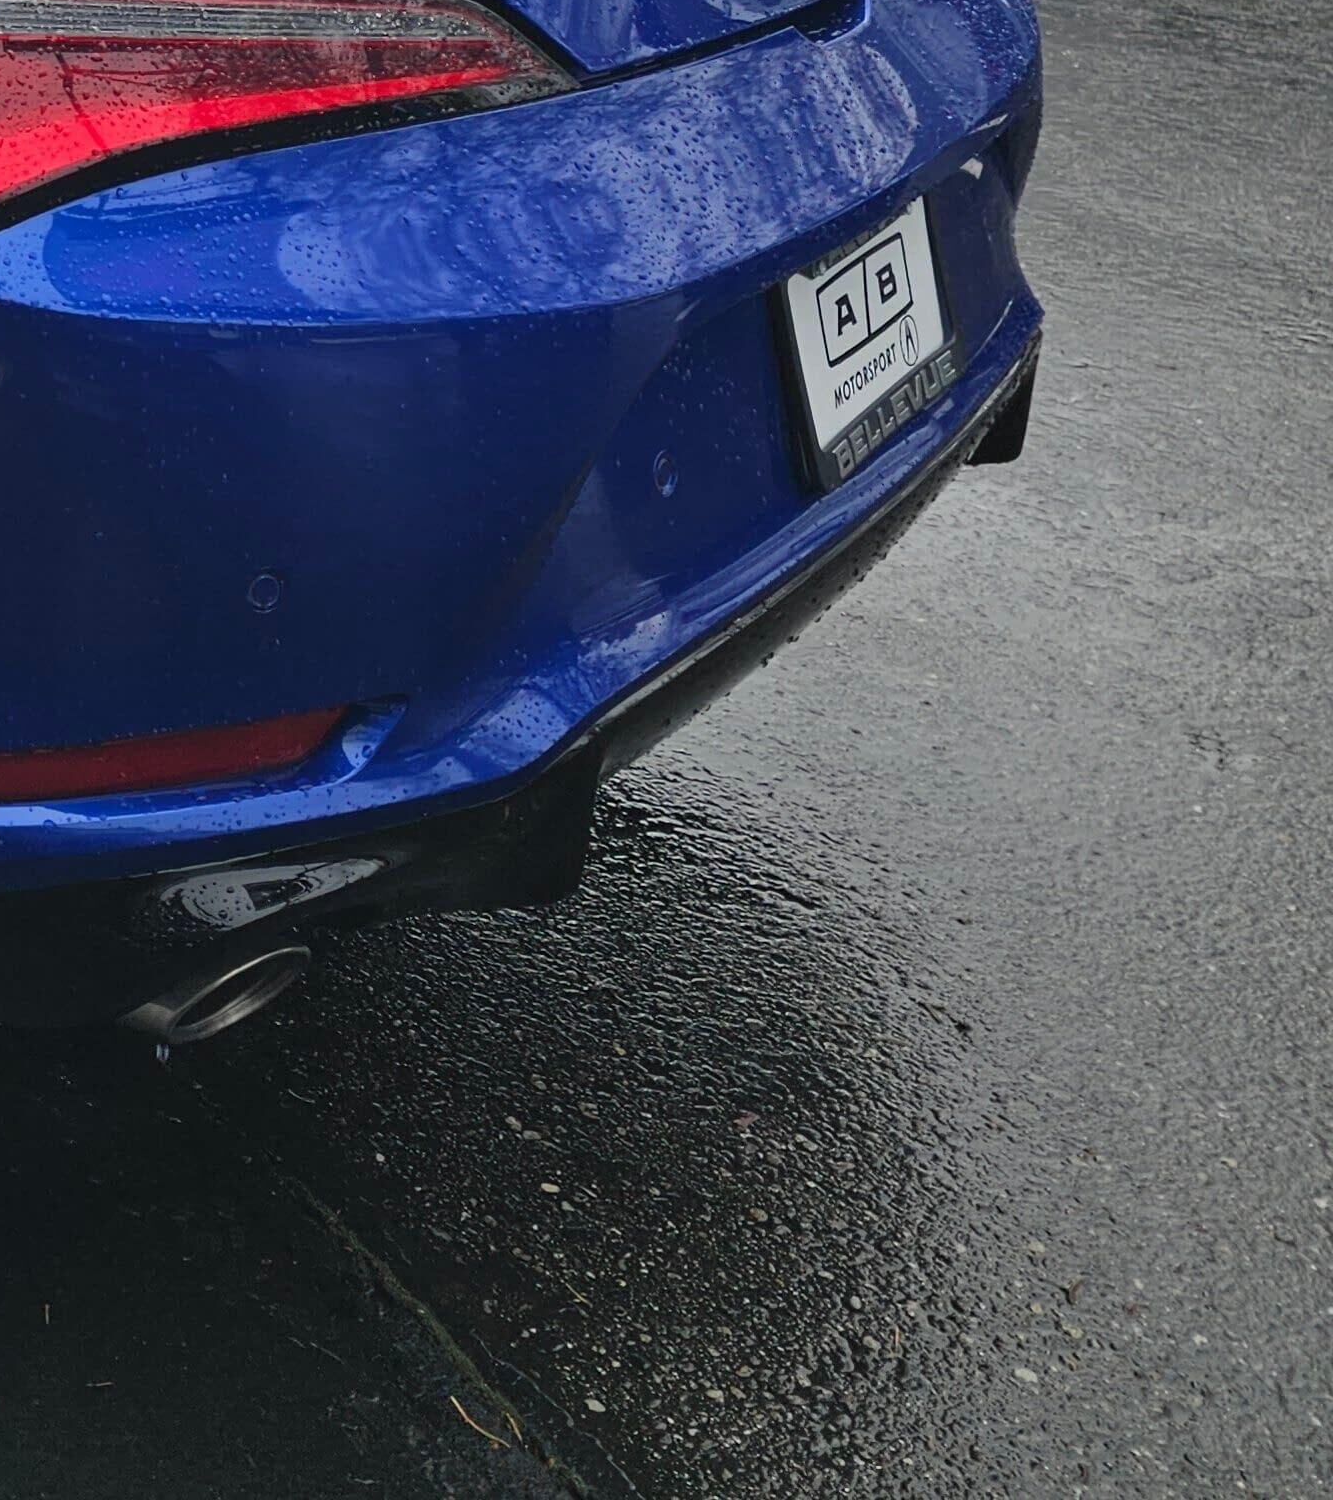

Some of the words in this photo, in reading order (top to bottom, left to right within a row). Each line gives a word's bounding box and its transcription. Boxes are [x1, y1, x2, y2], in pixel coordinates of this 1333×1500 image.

[834, 293, 857, 337] A
[875, 262, 898, 304] B
[833, 343, 898, 409] MOTORSPORT
[833, 350, 957, 479] BELLEVUE
